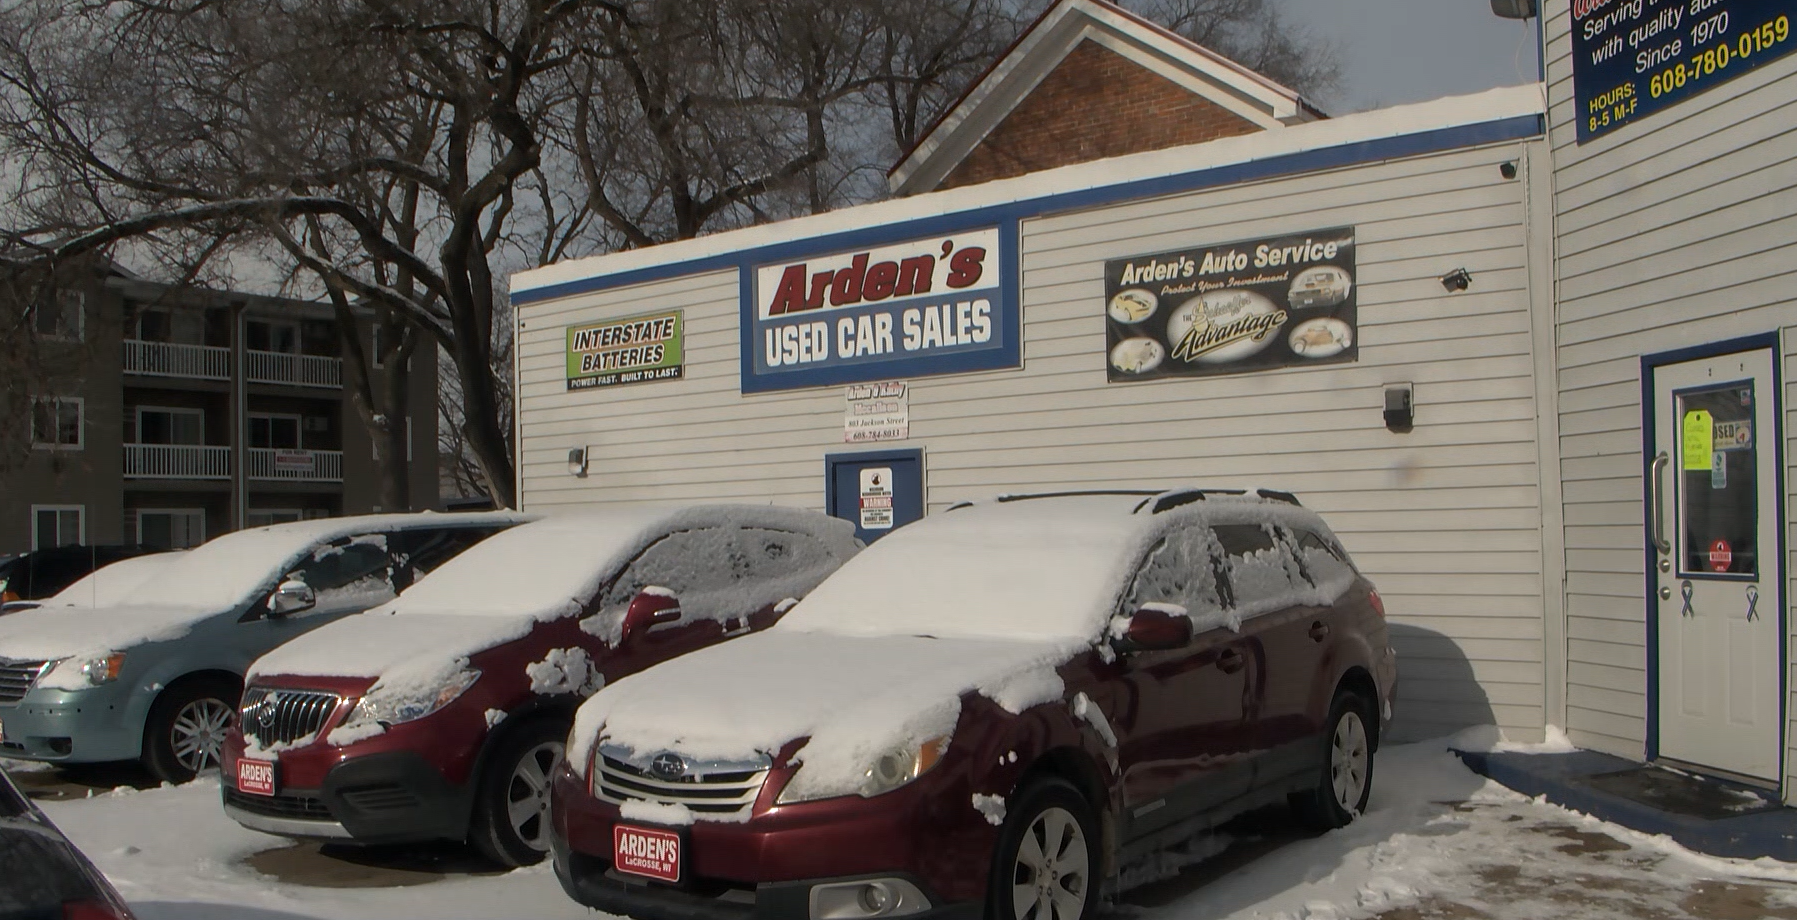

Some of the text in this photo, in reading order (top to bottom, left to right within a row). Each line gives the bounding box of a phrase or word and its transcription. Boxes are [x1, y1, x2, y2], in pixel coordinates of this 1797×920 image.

[1583, 0, 1643, 40] Serving
[1592, 35, 1623, 66] with
[1629, 5, 1684, 50] quality
[1635, 11, 1729, 74] Since 1970
[1589, 15, 1789, 114] HOURS: 608-780-0159
[1589, 98, 1638, 132] 8-5 M-F
[768, 240, 987, 316] Arden's
[1120, 238, 1338, 286] Arden's Auto Service
[1160, 270, 1289, 296] Protect Your Investment
[572, 316, 676, 352] INTERSTATE
[765, 299, 991, 367] USED CAR SALES
[1171, 310, 1288, 362] Advantage
[580, 343, 665, 373] BATTERIES
[571, 376, 596, 388] POWER
[597, 375, 618, 385] FAST.
[621, 372, 642, 383] BUILT
[644, 370, 655, 379] TO
[886, 417, 904, 425] Street
[863, 497, 892, 508] WARNING
[241, 764, 272, 782] ARDEN'S
[619, 832, 677, 864] ARDEN'S
[625, 855, 672, 873] LaCROSSE, WI
